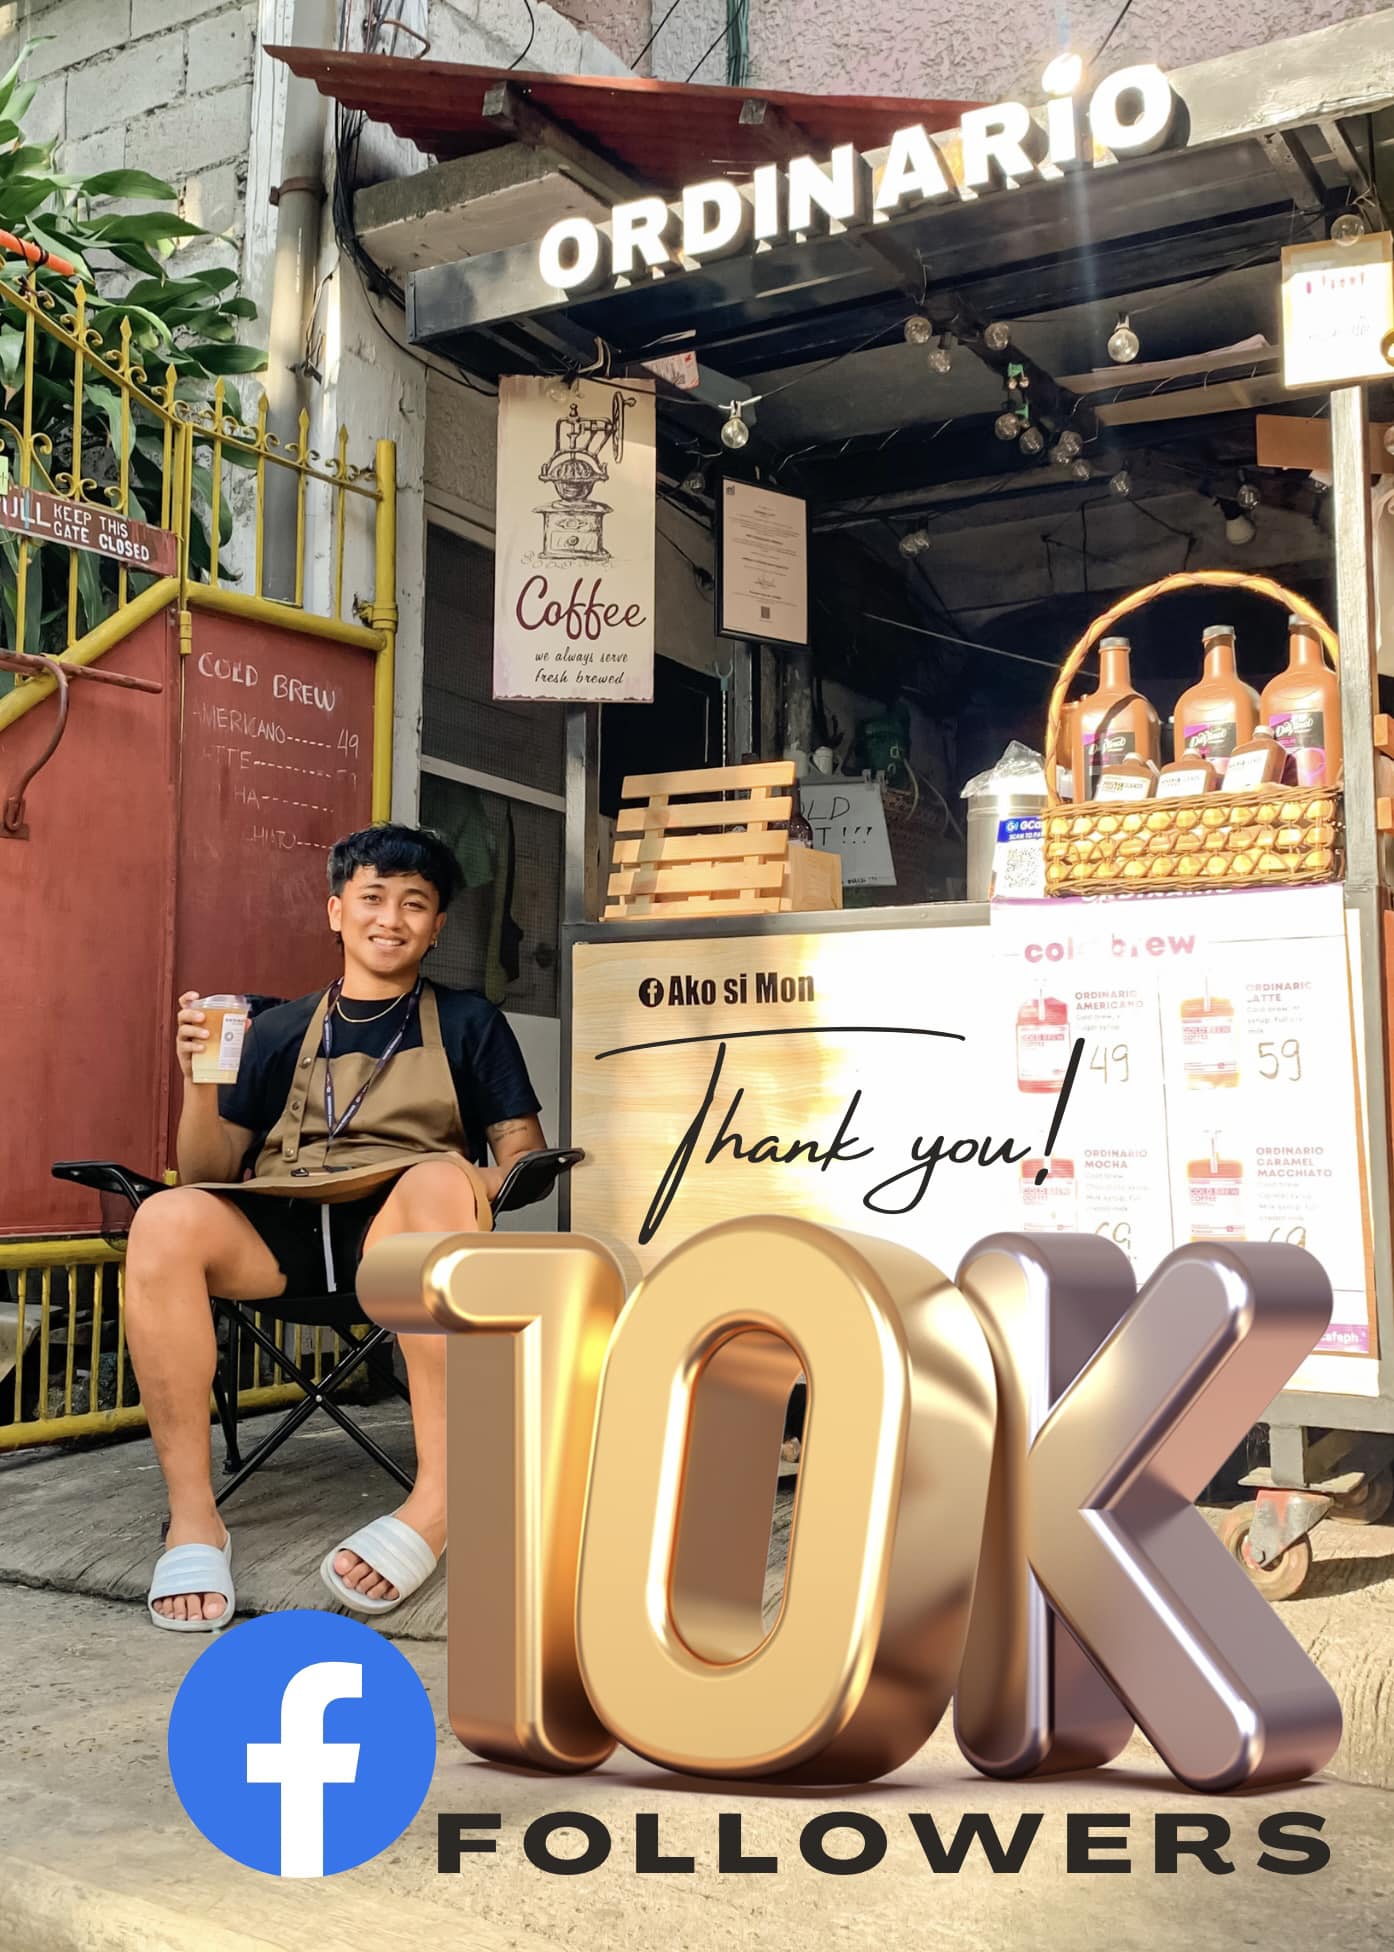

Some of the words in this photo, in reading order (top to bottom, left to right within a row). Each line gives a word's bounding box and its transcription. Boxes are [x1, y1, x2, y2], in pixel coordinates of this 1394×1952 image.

[0, 495, 51, 528] ULL
[54, 503, 92, 525] KEEP
[99, 516, 129, 539] THIS
[53, 521, 90, 544] GATE
[98, 533, 150, 561] CLOSED
[515, 575, 647, 640] Coffee
[535, 651, 551, 663] we
[554, 646, 594, 665] always
[599, 650, 630, 664] serve
[198, 651, 259, 687] COLD
[272, 674, 337, 712] BREW
[534, 667, 568, 684] fresh
[575, 670, 624, 685] brewed
[337, 728, 360, 758] 49
[1110, 931, 1197, 960] bew
[668, 975, 717, 1006] Ako
[723, 974, 748, 1005] si
[755, 971, 816, 1003] Mon
[1089, 1043, 1130, 1085] 49
[1257, 1038, 1303, 1082] 59
[1084, 1149, 1148, 1158] ORDINARIO
[1084, 1160, 1128, 1169] MOCHA
[1256, 1146, 1325, 1156] ORDINARIO
[1256, 1158, 1314, 1167] CARAMEL
[1257, 1168, 1333, 1177] MACCHIATO
